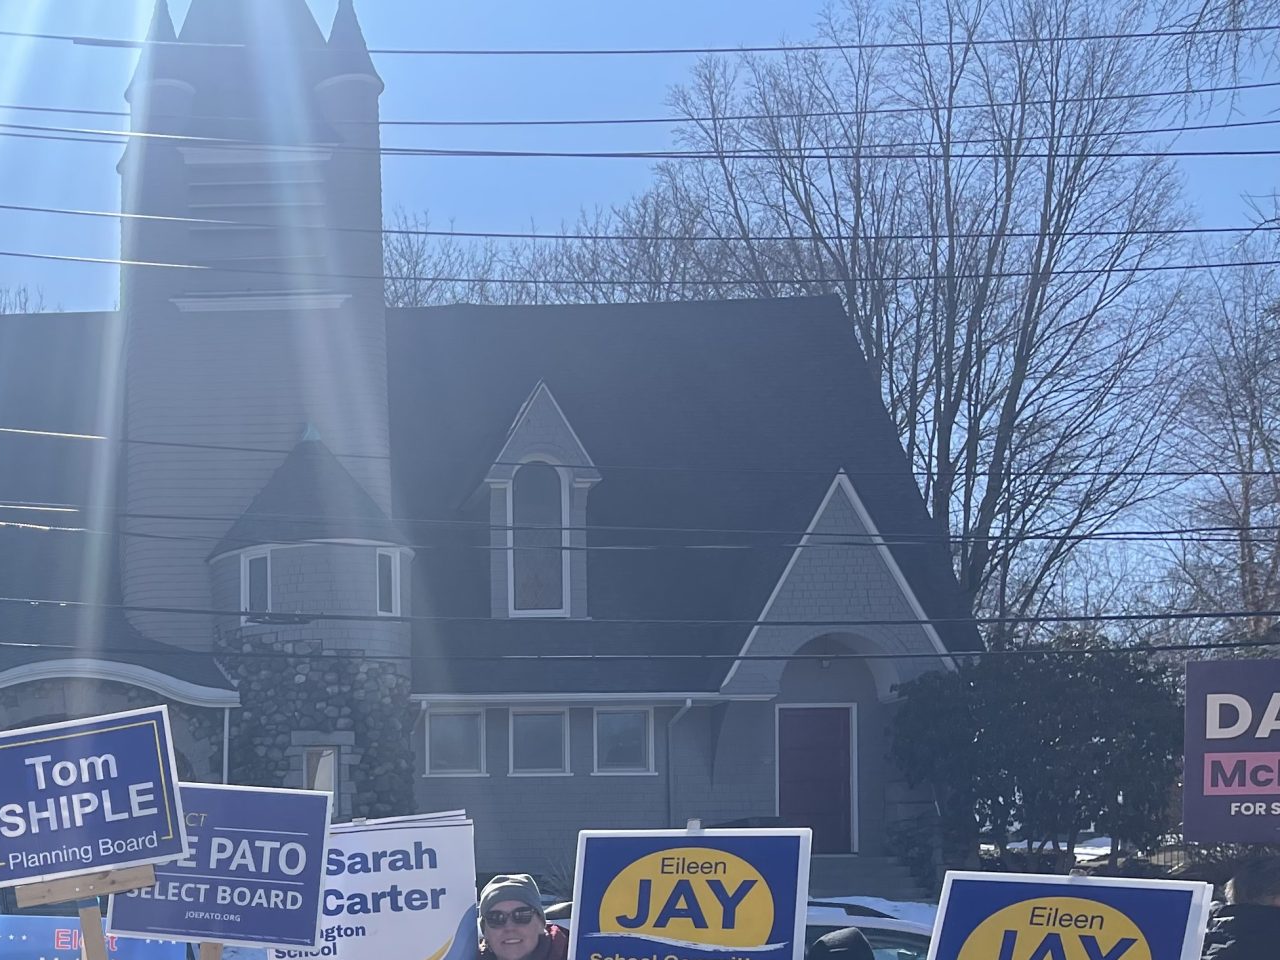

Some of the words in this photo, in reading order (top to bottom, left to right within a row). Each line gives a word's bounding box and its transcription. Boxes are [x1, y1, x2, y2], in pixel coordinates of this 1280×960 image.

[1205, 692, 1280, 740] DA
[24, 753, 118, 790] Tom
[0, 781, 158, 838] SHIPLE
[1230, 802, 1266, 816] FOR
[8, 844, 93, 870] Planning
[98, 830, 158, 856] Board
[208, 837, 307, 876] PATO
[325, 841, 438, 876] Sarah
[660, 857, 727, 875] Eileen
[216, 885, 303, 911] BOARD
[322, 884, 447, 917] Carter
[615, 879, 759, 930] JAY
[184, 911, 241, 922] JOEPATO.ORG
[1028, 906, 1105, 930] Eileen
[54, 928, 118, 951] Elt
